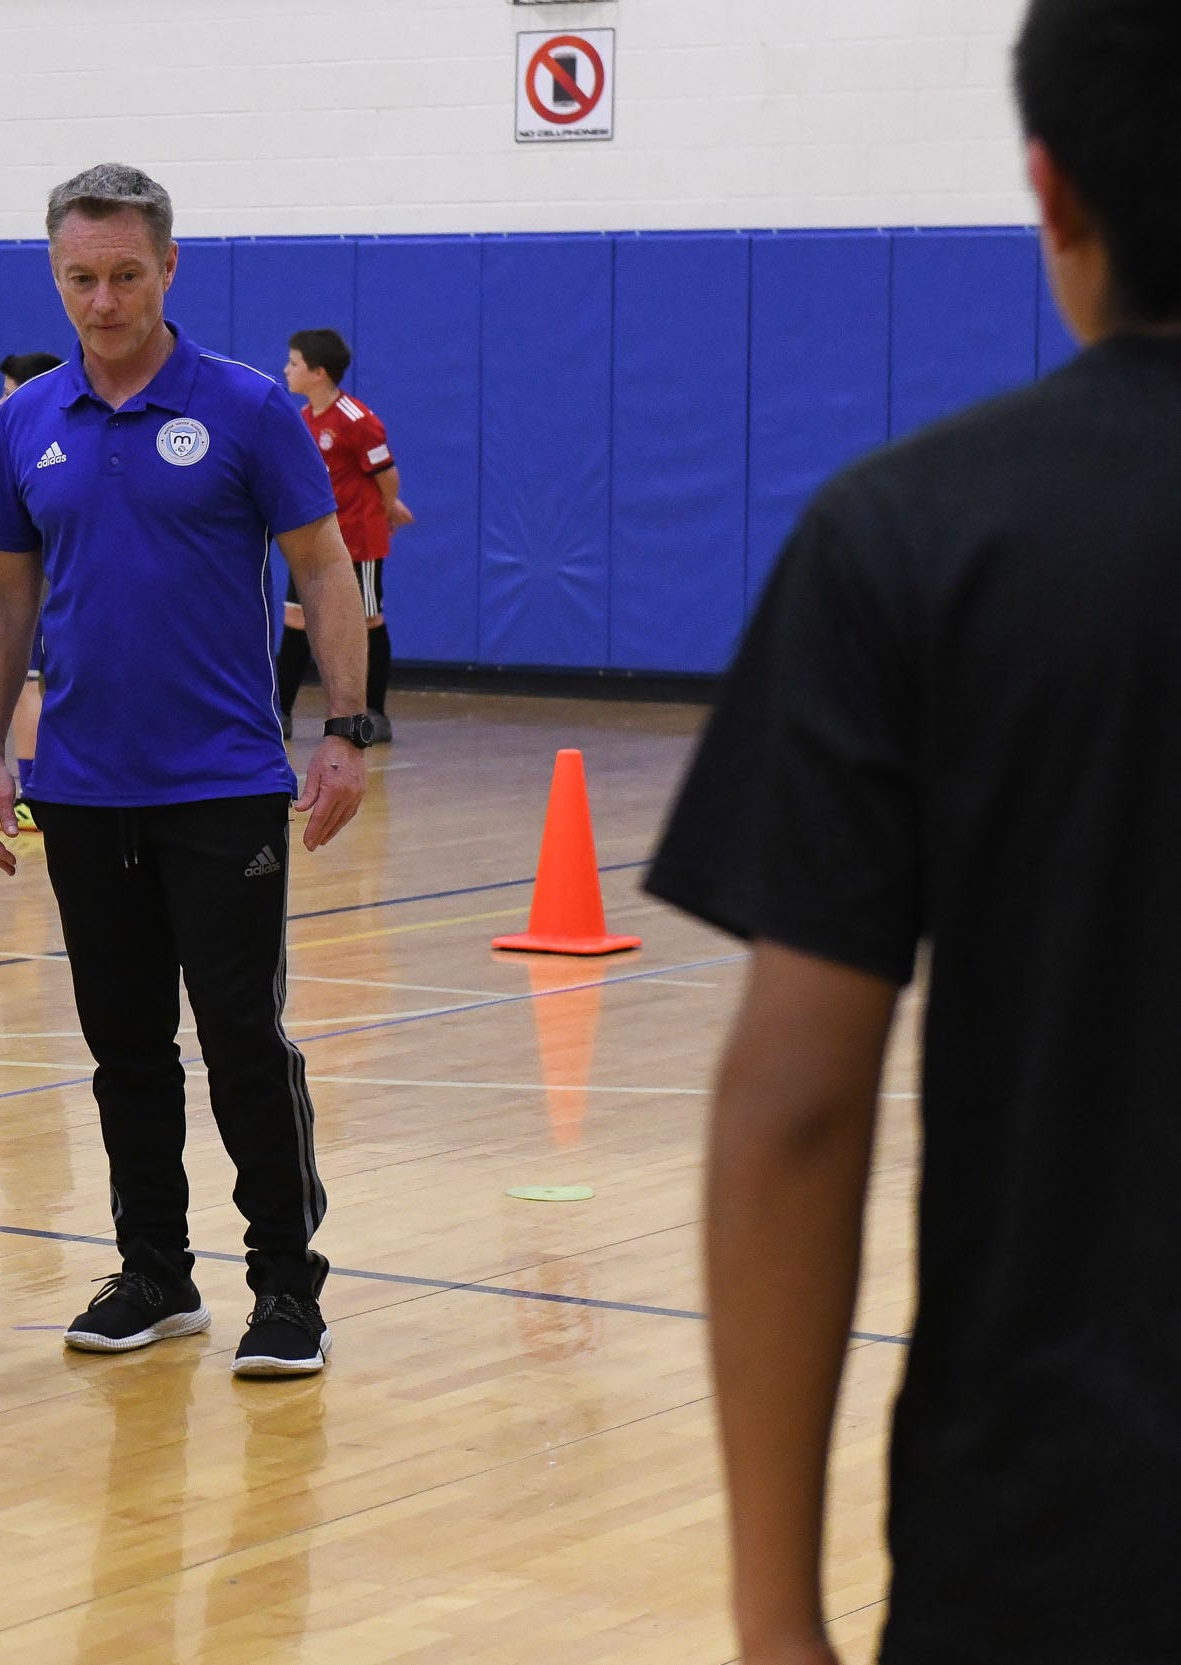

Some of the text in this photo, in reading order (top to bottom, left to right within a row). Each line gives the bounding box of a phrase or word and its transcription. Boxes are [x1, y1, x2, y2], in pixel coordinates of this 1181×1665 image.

[519, 129, 535, 137] NO
[36, 454, 67, 469] adidas
[244, 862, 280, 877] adidas
